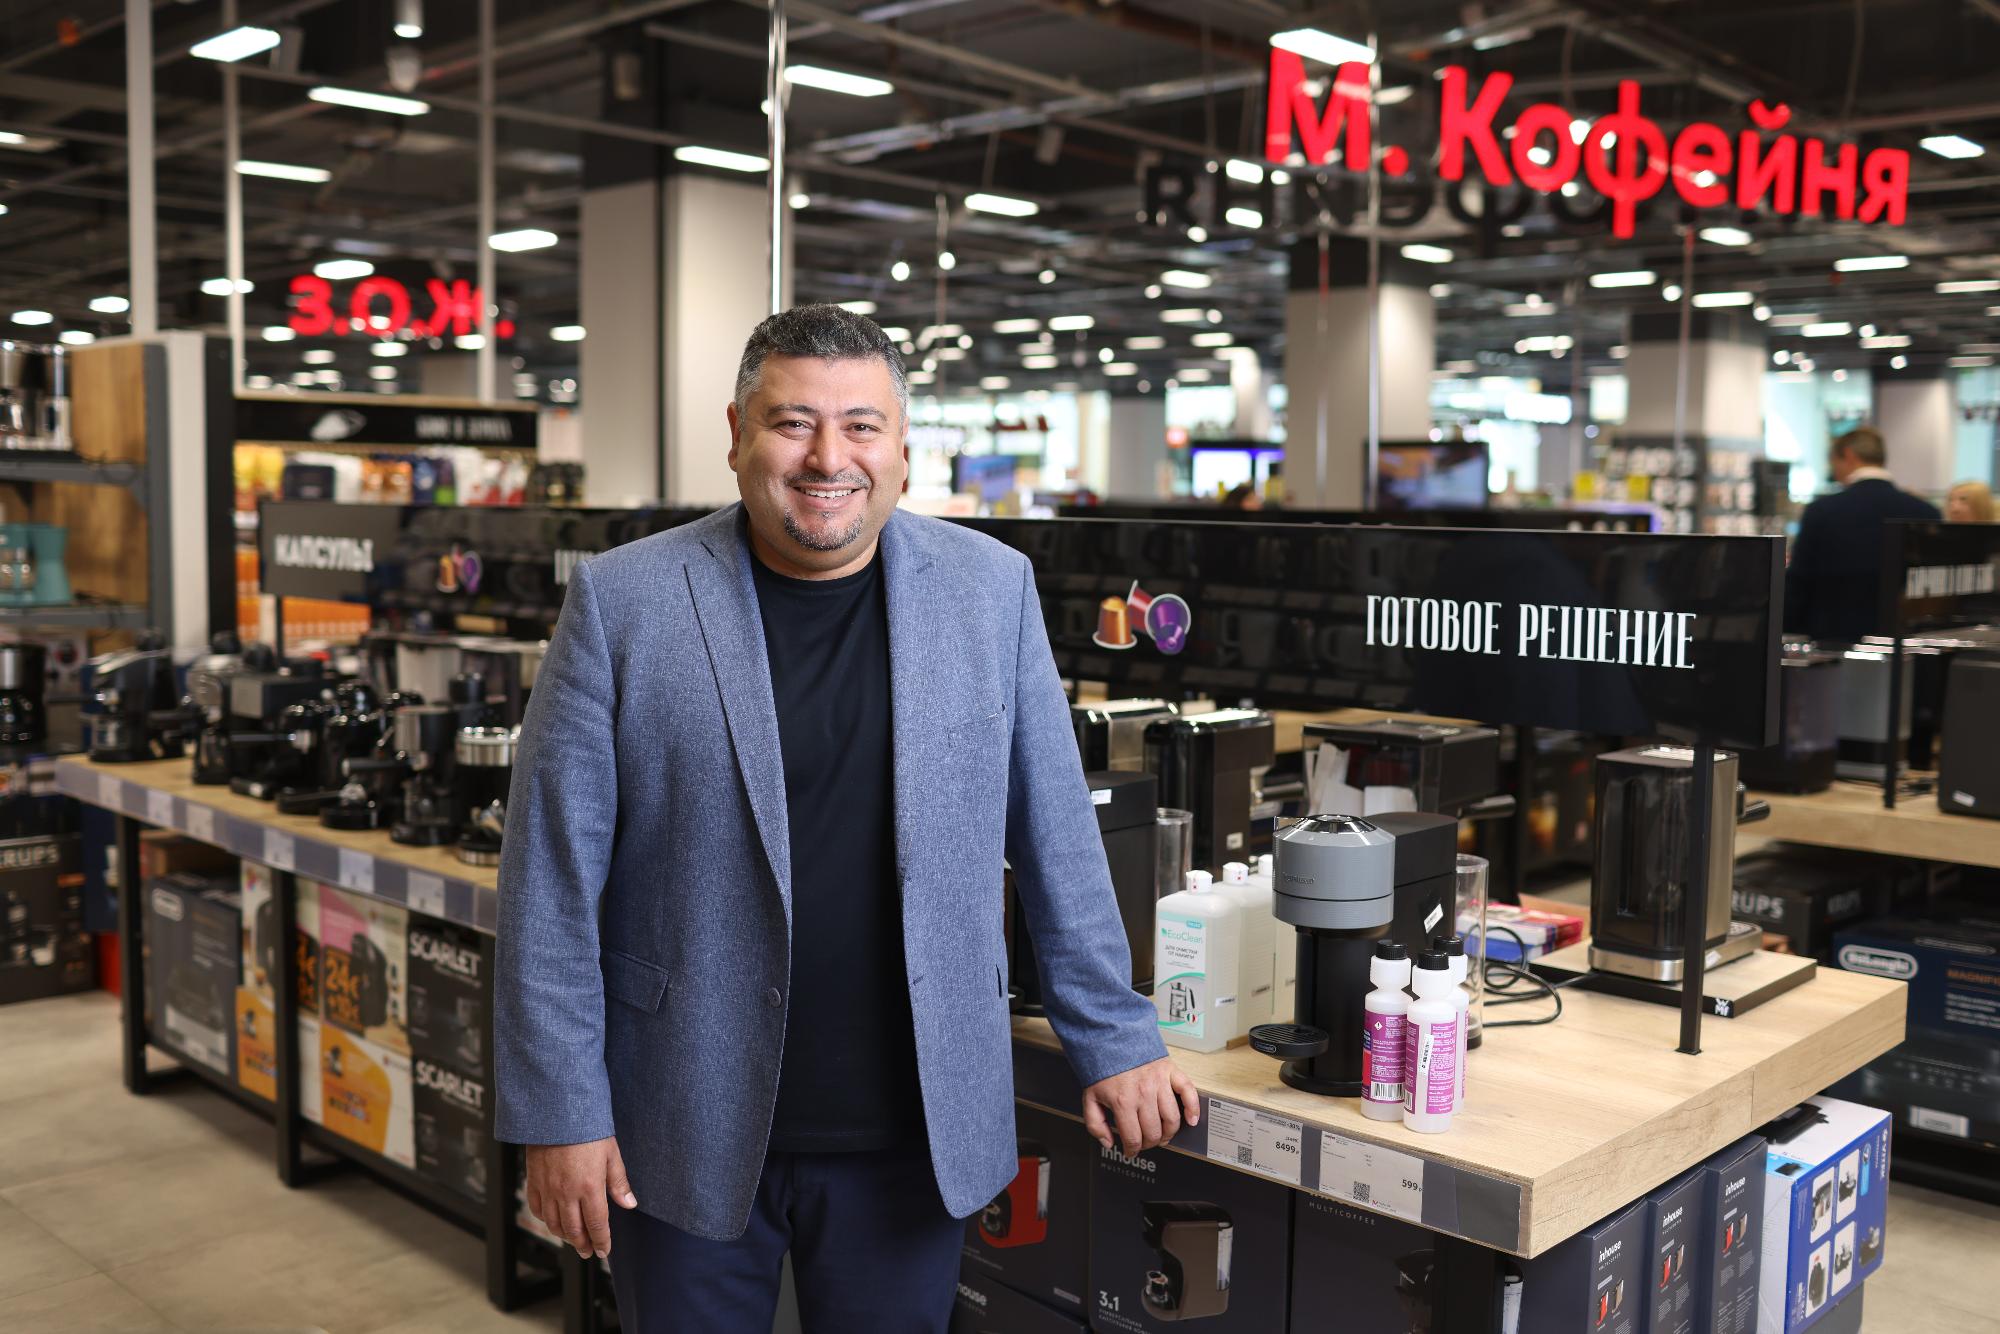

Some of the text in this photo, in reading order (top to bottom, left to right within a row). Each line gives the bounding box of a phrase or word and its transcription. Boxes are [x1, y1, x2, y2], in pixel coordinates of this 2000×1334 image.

[1265, 46, 1910, 239] М. Кофейня
[275, 534, 374, 572] КАПСУЛЫ
[1366, 595, 1697, 669] ГОТОВОЕ РЕШЕНИЕ
[0, 844, 59, 869] RUPS
[1732, 889, 1785, 919] RUPS
[1167, 929, 1203, 944] EcoClean
[410, 931, 481, 977] SCARLET
[415, 1060, 485, 1108] SCARLET
[1725, 1176, 1746, 1197] inhouse
[1308, 1201, 1376, 1226] MULTICOFFEE
[1662, 1206, 1683, 1228] inhouse
[1598, 1240, 1622, 1264] inhouse
